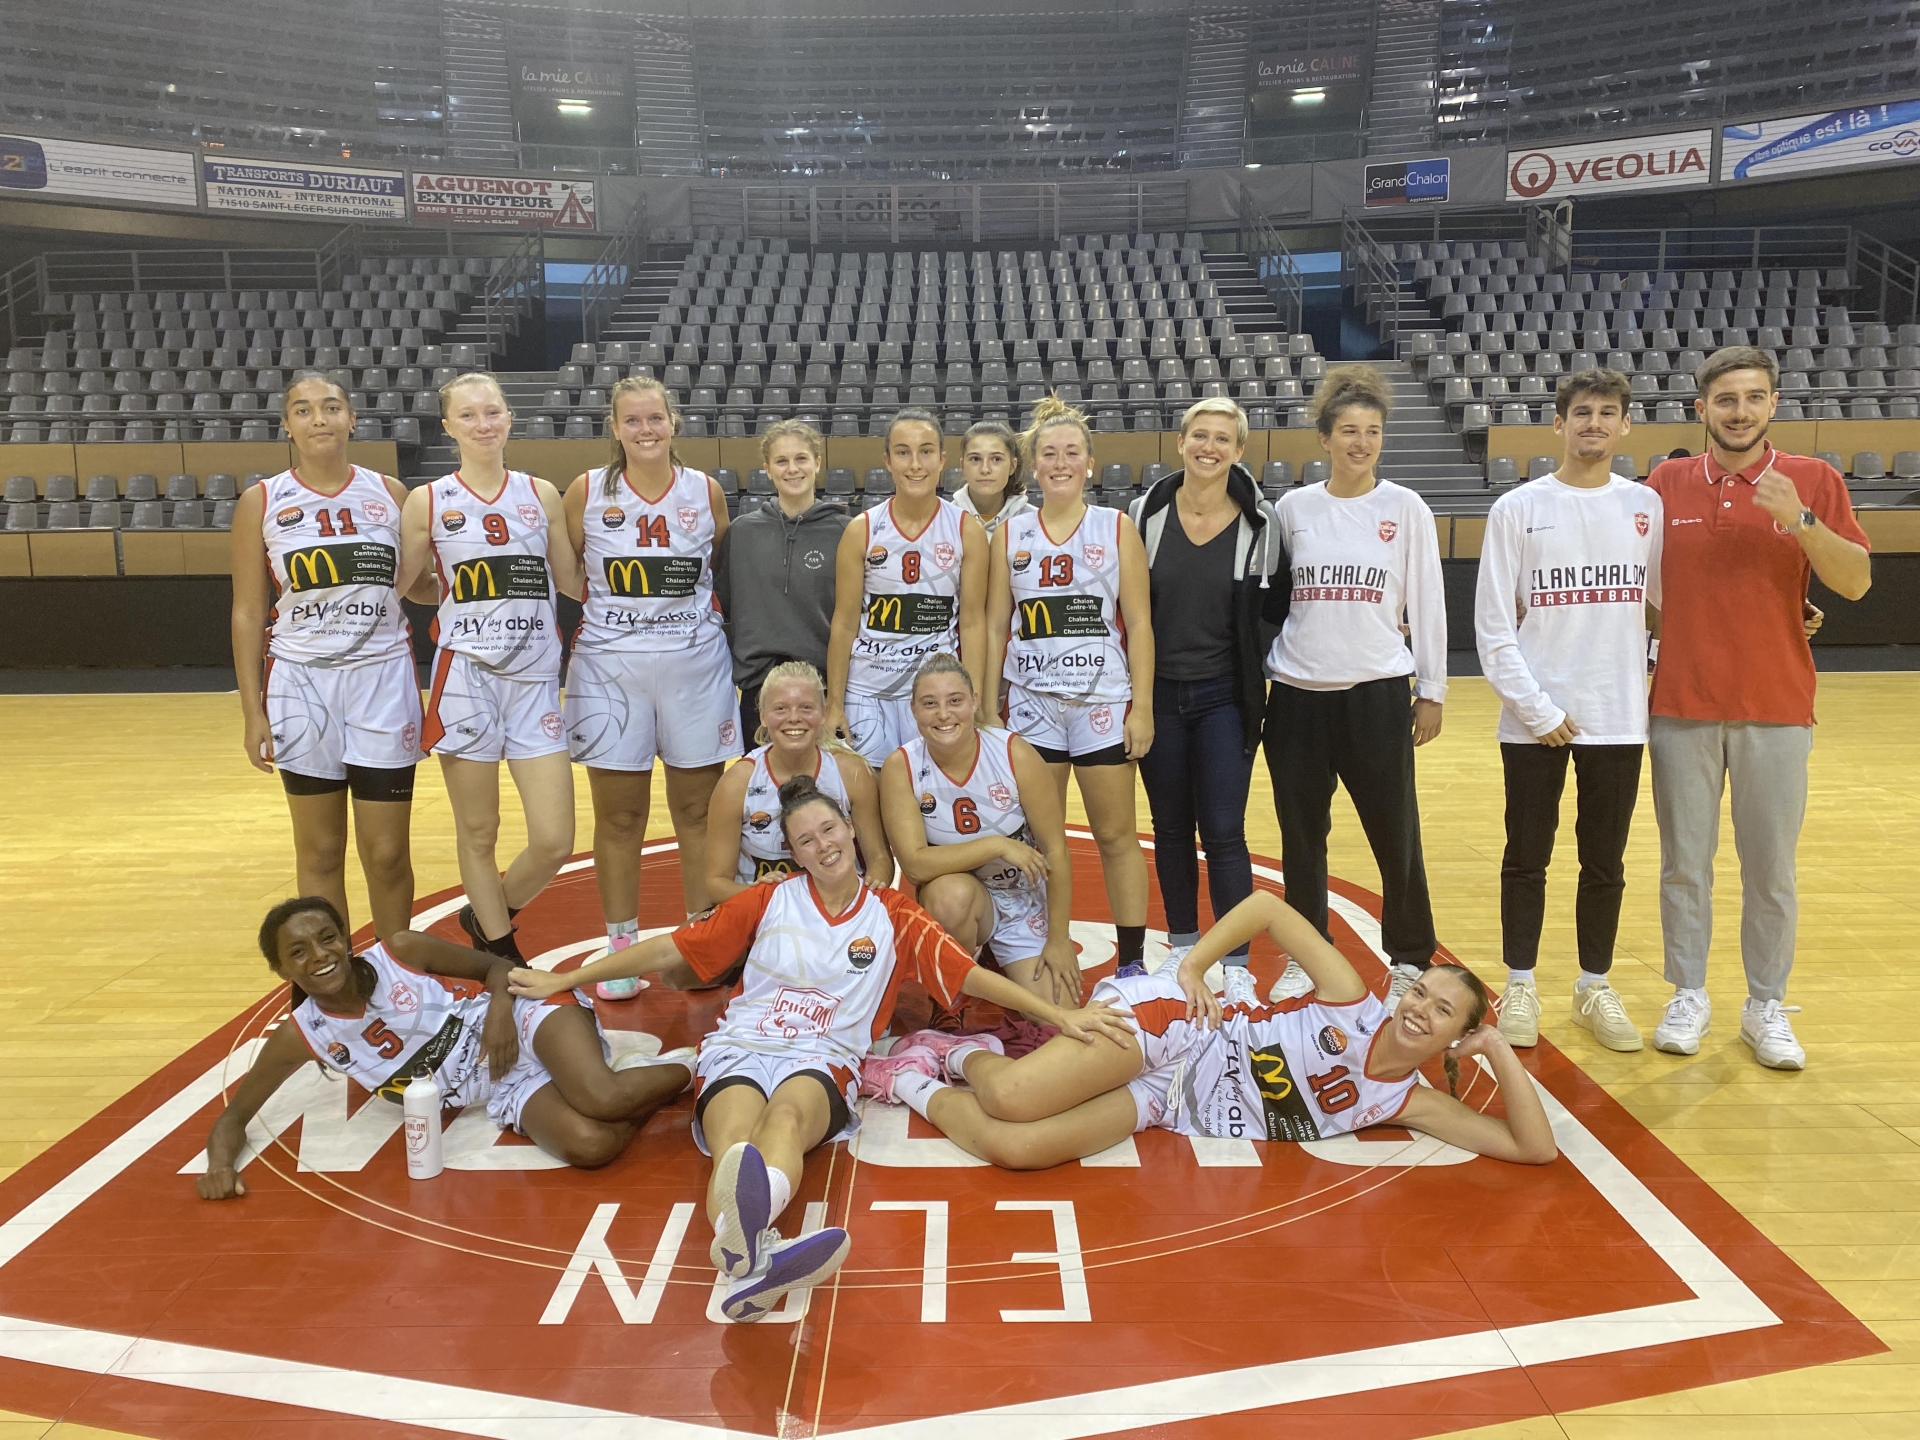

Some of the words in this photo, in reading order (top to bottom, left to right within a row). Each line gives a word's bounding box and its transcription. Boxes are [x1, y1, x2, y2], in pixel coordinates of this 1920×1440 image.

[521, 65, 538, 81] la
[540, 67, 571, 83] mie
[1258, 61, 1274, 76] la
[1275, 58, 1307, 75] mie
[1771, 133, 1811, 156] optique
[1815, 119, 1844, 140] est
[1849, 109, 1871, 130] là
[50, 161, 107, 177] L'esprit
[112, 168, 187, 184] connecté
[1565, 147, 1706, 184] VEOLIA
[213, 165, 305, 184] TRANSPORTS
[309, 173, 395, 193] DURIAUT
[416, 175, 552, 196] AGUENOT
[217, 186, 283, 199] NATIONAL
[295, 192, 395, 207] INTERNATIONAL
[417, 191, 554, 209] EXTINCTEUR
[219, 198, 250, 208] 71510
[252, 200, 396, 218] SAINT-LEGER-SUR-DHEUNE
[417, 206, 448, 214] DANS
[451, 207, 464, 215] LE
[467, 208, 487, 216] FEU
[490, 209, 505, 217] DE
[508, 210, 554, 219] L'ACTION
[789, 194, 823, 222] Le
[314, 507, 358, 537] 11
[482, 512, 510, 547] 9
[636, 513, 671, 548] 14
[361, 544, 385, 552] Chalon
[357, 562, 381, 570] Chalon
[510, 564, 545, 573] Centre-Ville
[518, 558, 538, 566] Chalon
[663, 565, 698, 573] Centre-Ville
[671, 559, 692, 567] Chalon
[902, 550, 921, 585] 8
[1038, 553, 1074, 588] 13
[533, 577, 543, 585] Sud
[1319, 565, 1388, 589] CHALON
[1581, 564, 1647, 588] CHALON
[507, 589, 528, 597] Chalon
[923, 597, 943, 605] Chalon
[345, 601, 387, 617] able
[657, 611, 698, 622] able
[505, 616, 545, 631] able
[901, 643, 939, 657] able
[1017, 654, 1045, 674] PLV
[1062, 653, 1106, 668] able
[1034, 680, 1093, 688] www.plv-by-able.fr
[952, 796, 982, 836] 6
[850, 945, 875, 954] SPORT
[852, 952, 872, 960] 2000
[361, 1017, 404, 1060] 5
[1323, 1031, 1337, 1052] 2000
[1327, 1026, 1344, 1051] SPORT
[1306, 1064, 1360, 1115] 10
[1268, 1111, 1277, 1138] Chalon
